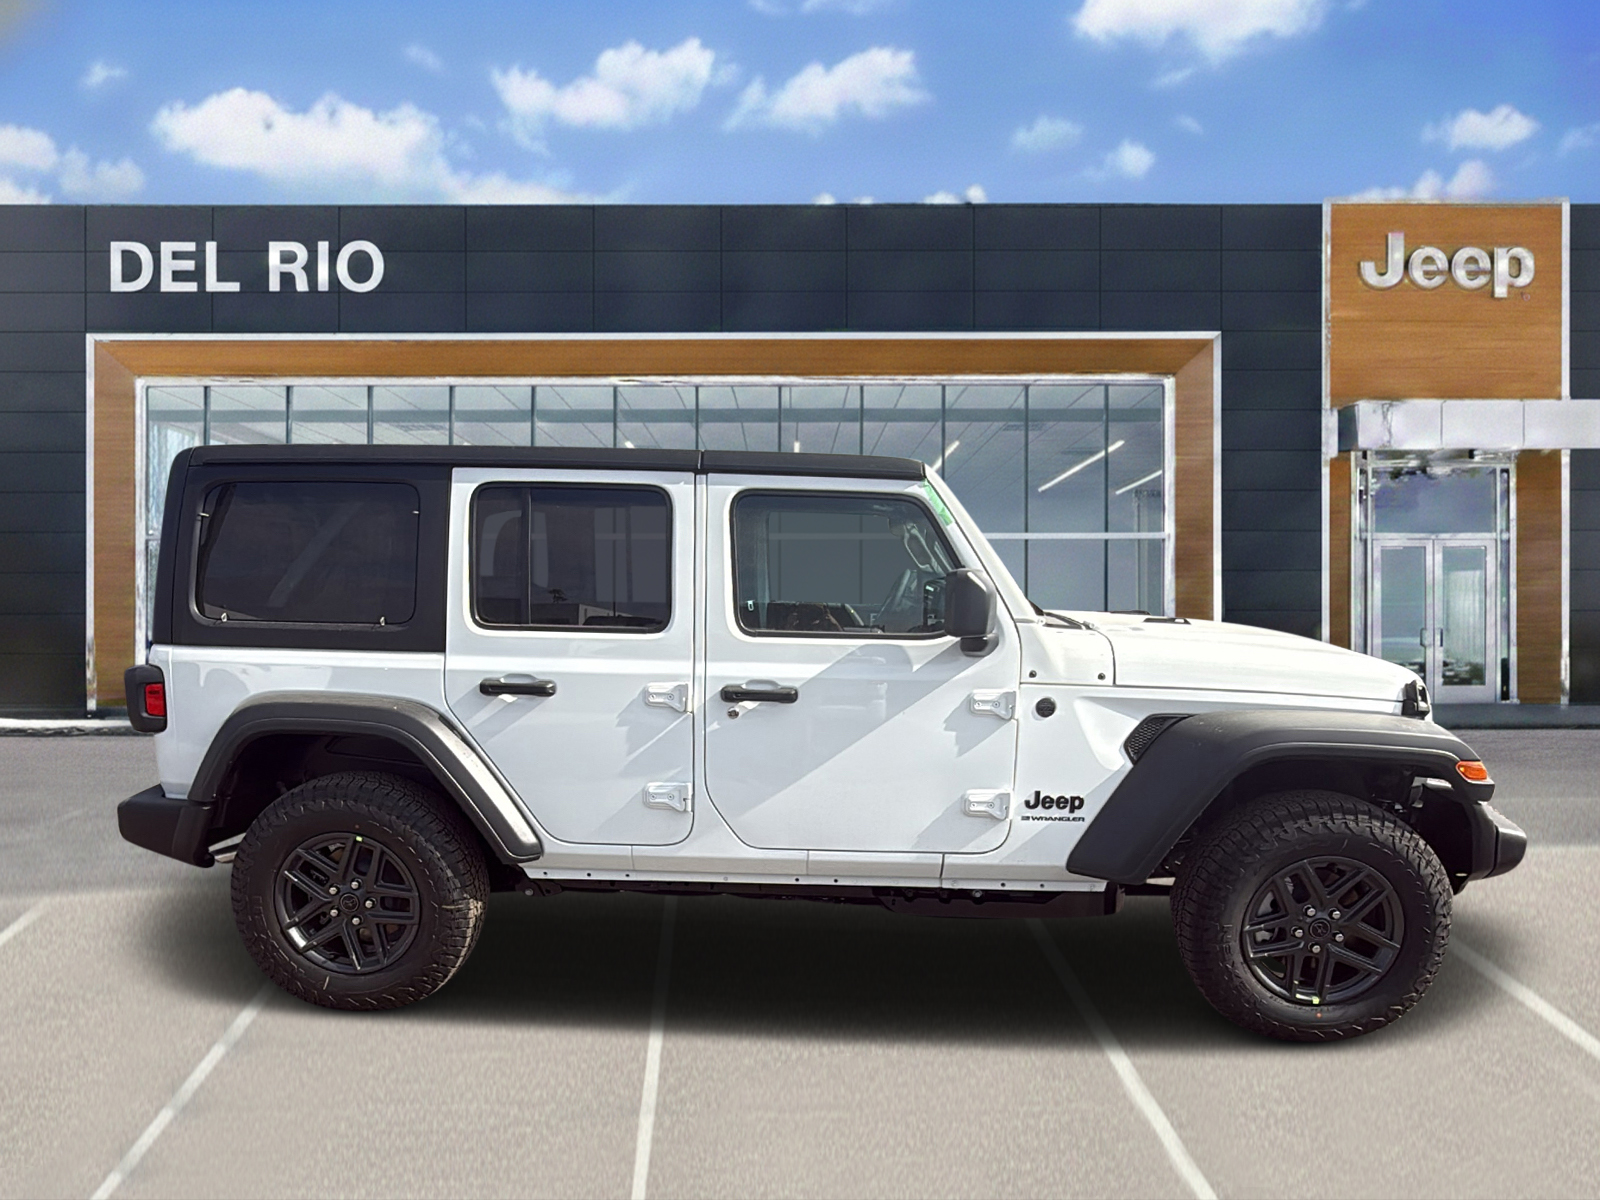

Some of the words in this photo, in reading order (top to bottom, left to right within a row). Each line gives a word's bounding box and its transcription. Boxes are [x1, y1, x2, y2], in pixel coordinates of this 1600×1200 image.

[110, 241, 241, 292] DEL
[268, 240, 385, 293] RIO
[1359, 230, 1535, 298] Jeep
[1024, 790, 1084, 814] Jeep
